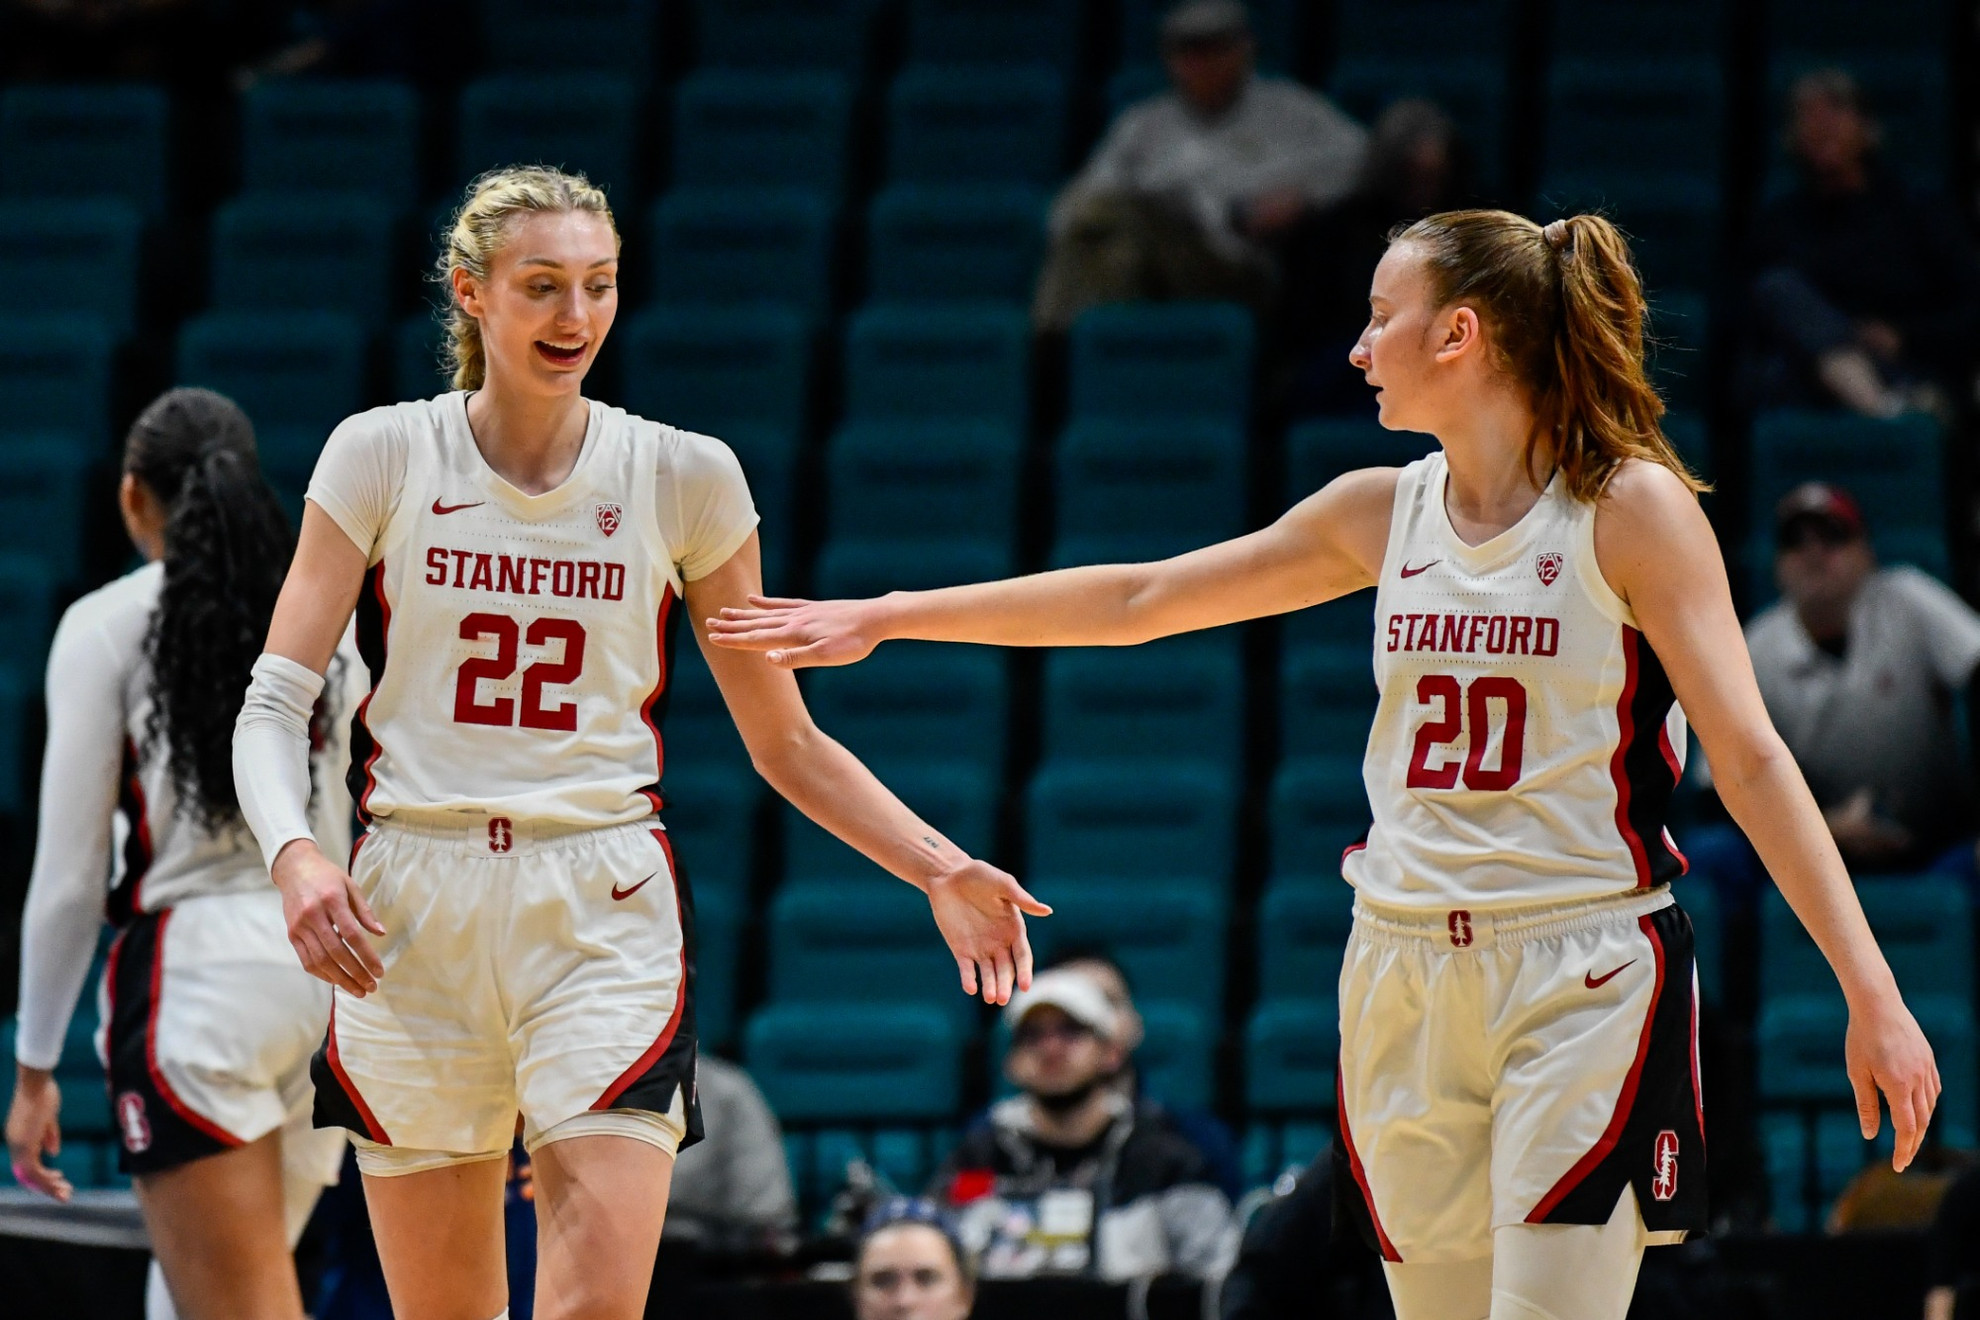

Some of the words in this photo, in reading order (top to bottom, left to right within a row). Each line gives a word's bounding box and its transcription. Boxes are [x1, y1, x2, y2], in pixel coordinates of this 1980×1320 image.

[602, 517, 615, 530] 12
[426, 547, 625, 601] STANFORD
[1541, 567, 1556, 580] 12
[1387, 614, 1559, 657] STANFORD
[453, 612, 586, 731] 22
[1406, 674, 1527, 791] 20
